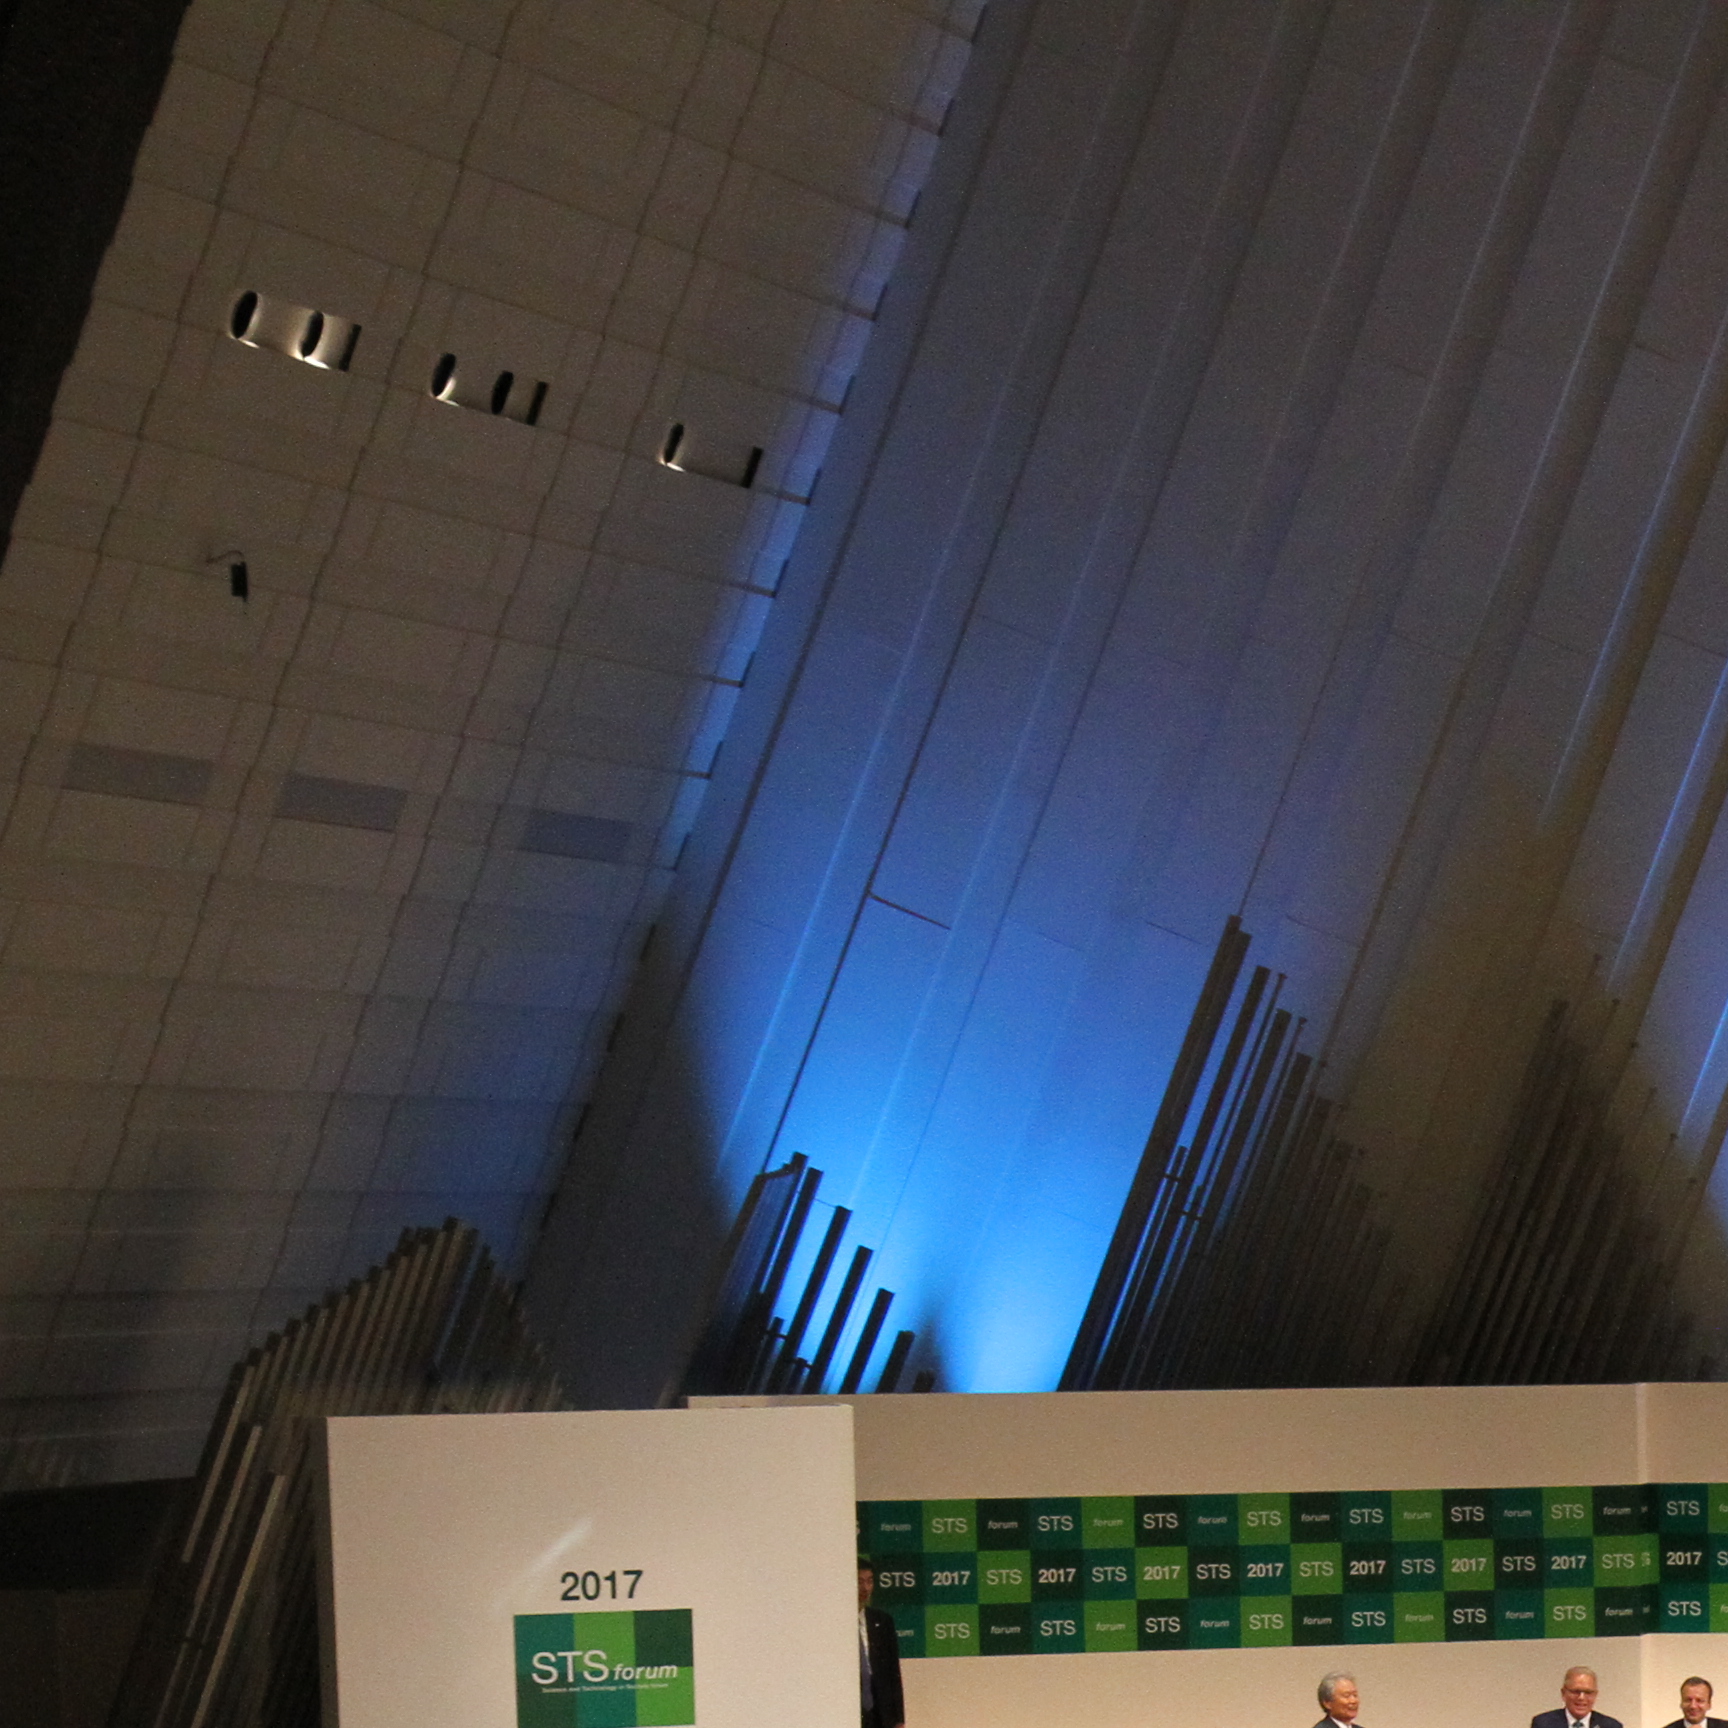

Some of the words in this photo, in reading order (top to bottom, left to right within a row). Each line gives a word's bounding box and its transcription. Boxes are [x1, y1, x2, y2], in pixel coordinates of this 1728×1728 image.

[880, 1572, 915, 1588] STS
[933, 1571, 970, 1585] 2017
[987, 1569, 1022, 1585] STS
[1039, 1568, 1076, 1583] 2017
[1092, 1566, 1127, 1582] STS
[1144, 1566, 1180, 1580] 2017
[1197, 1564, 1231, 1579] STS
[1248, 1563, 1283, 1577] 2017
[1300, 1561, 1333, 1577] STS
[1350, 1560, 1386, 1575] 2017
[1402, 1559, 1435, 1574] STS
[1451, 1558, 1486, 1572] 2017
[1503, 1556, 1535, 1571] STS
[1552, 1555, 1586, 1569] 2017
[1602, 1554, 1635, 1568] STS
[1667, 1552, 1702, 1565] 2017
[561, 1570, 642, 1601] 2017
[532, 1649, 610, 1684] STS
[614, 1663, 679, 1681] forum
